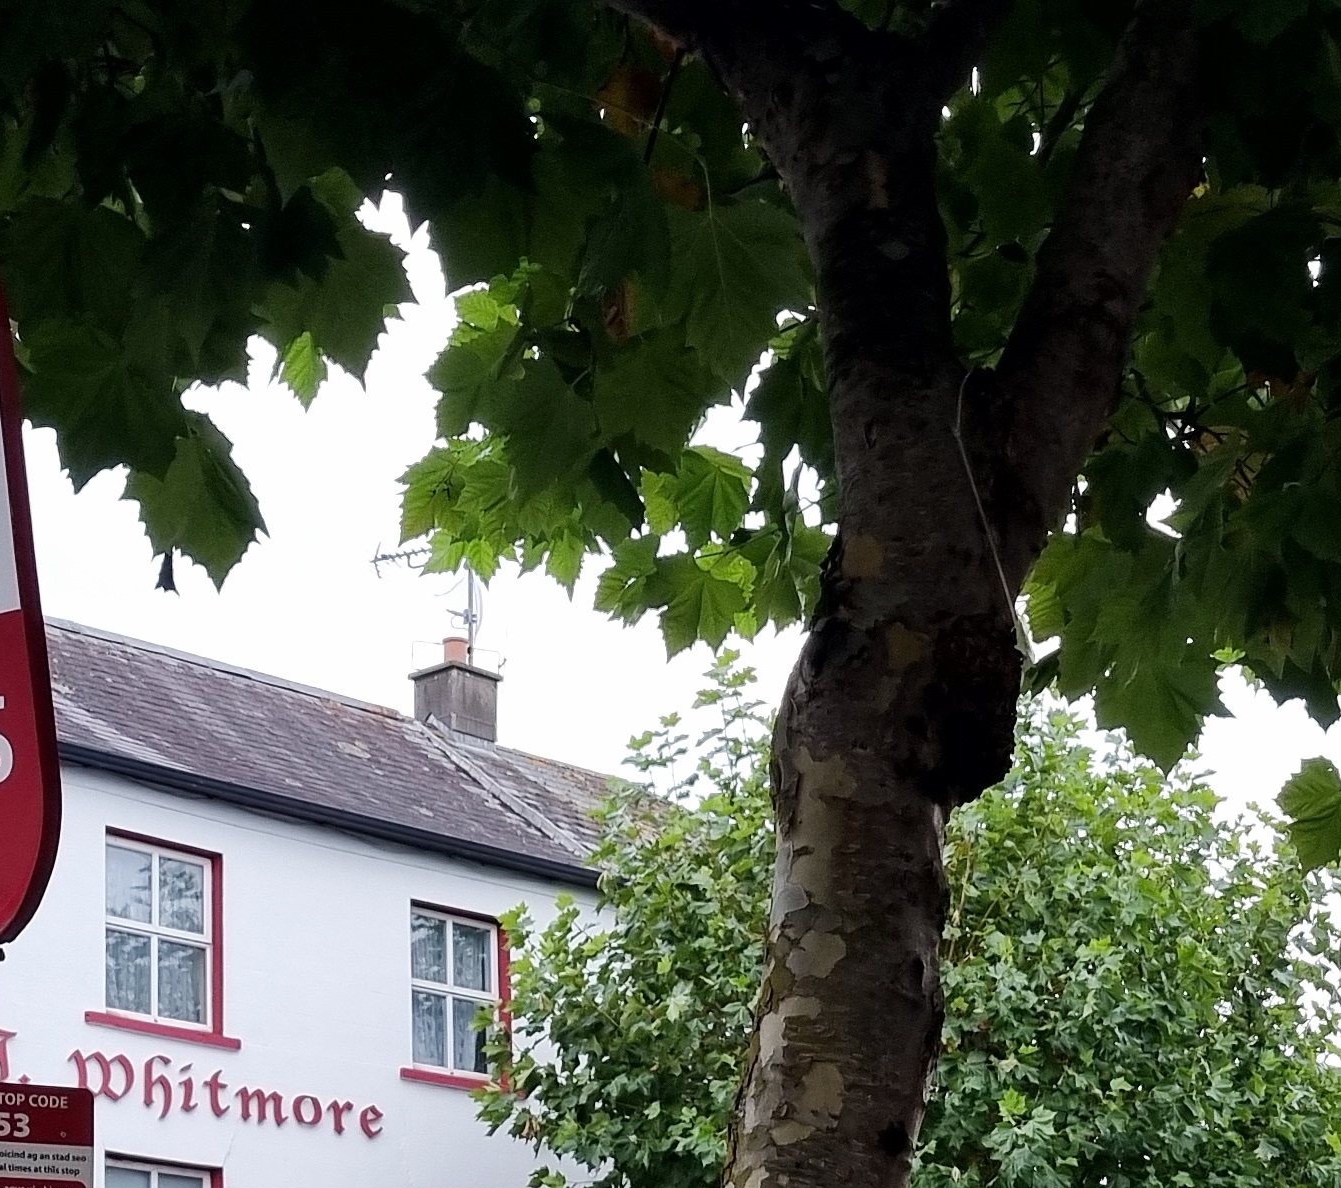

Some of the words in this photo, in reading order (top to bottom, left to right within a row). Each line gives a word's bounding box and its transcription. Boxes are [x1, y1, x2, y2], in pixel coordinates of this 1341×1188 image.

[68, 1049, 385, 1139] Whitmore
[28, 1094, 69, 1109] CODE
[27, 1153, 38, 1162] ag
[52, 1153, 70, 1162] stad
[72, 1155, 86, 1163] seo
[8, 1164, 32, 1173] times
[34, 1165, 42, 1173] at
[44, 1165, 59, 1174] this
[61, 1167, 80, 1177] stop
